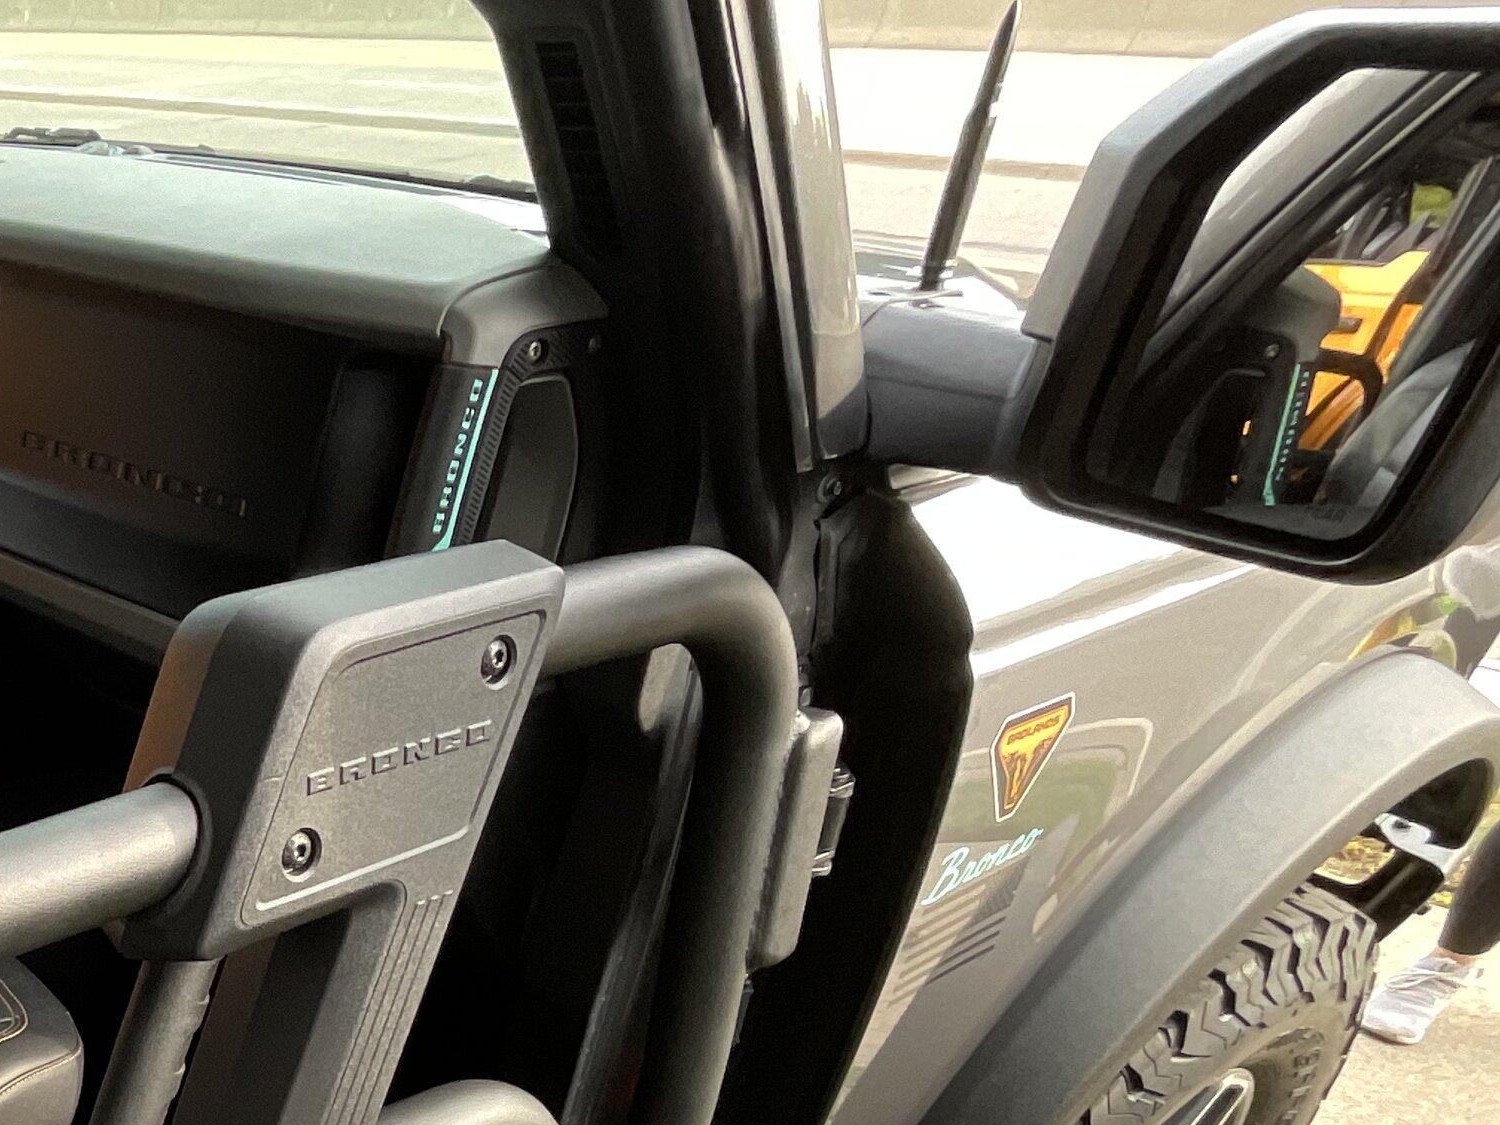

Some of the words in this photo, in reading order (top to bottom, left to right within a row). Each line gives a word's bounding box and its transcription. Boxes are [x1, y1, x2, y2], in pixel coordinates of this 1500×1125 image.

[432, 378, 484, 534] BRONCO
[306, 718, 493, 796] BRONCO
[920, 827, 1045, 906] Bronco
